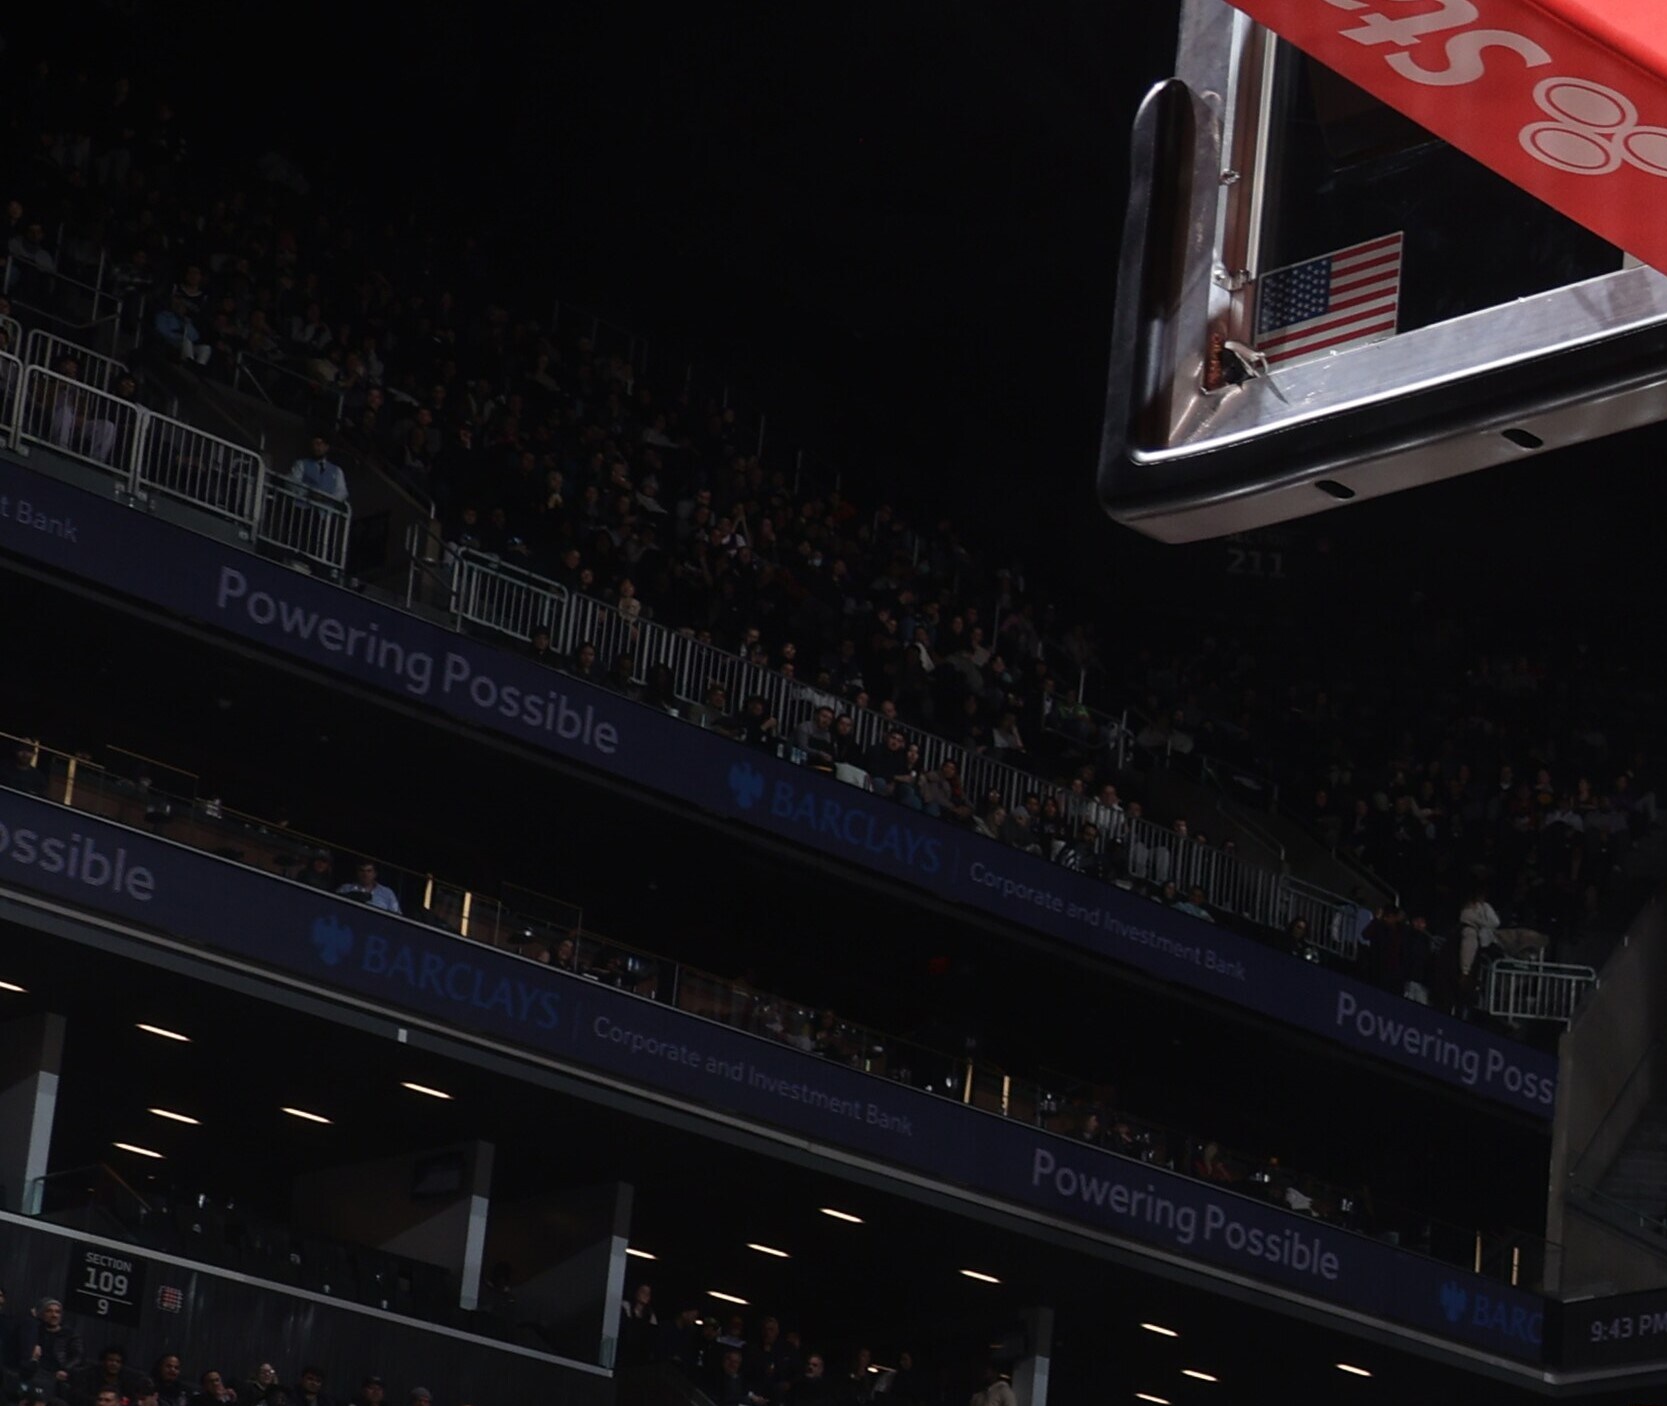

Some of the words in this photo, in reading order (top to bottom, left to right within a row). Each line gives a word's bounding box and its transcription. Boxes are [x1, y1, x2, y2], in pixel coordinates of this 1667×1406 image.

[16, 499, 78, 543] Bank
[217, 564, 432, 695] Powering
[442, 651, 619, 754] Possible
[769, 780, 944, 874] BARCLAYS
[969, 861, 1065, 912] Corporate
[1067, 904, 1101, 927] and
[1103, 911, 1203, 965] Investment
[1204, 949, 1246, 981] Bank
[361, 934, 561, 1029] BARCLAYS
[592, 1016, 700, 1069] Corporate
[704, 1056, 743, 1083] and
[747, 1066, 862, 1120] Investment
[865, 1102, 913, 1137] Bank
[1335, 990, 1480, 1085] Powering
[1032, 1147, 1198, 1244] Powering
[1203, 1203, 1340, 1280] Possible
[84, 1267, 129, 1297] 109
[85, 1252, 132, 1272] SECTION
[97, 1299, 109, 1316] 9
[1590, 1316, 1633, 1342] 9:43
